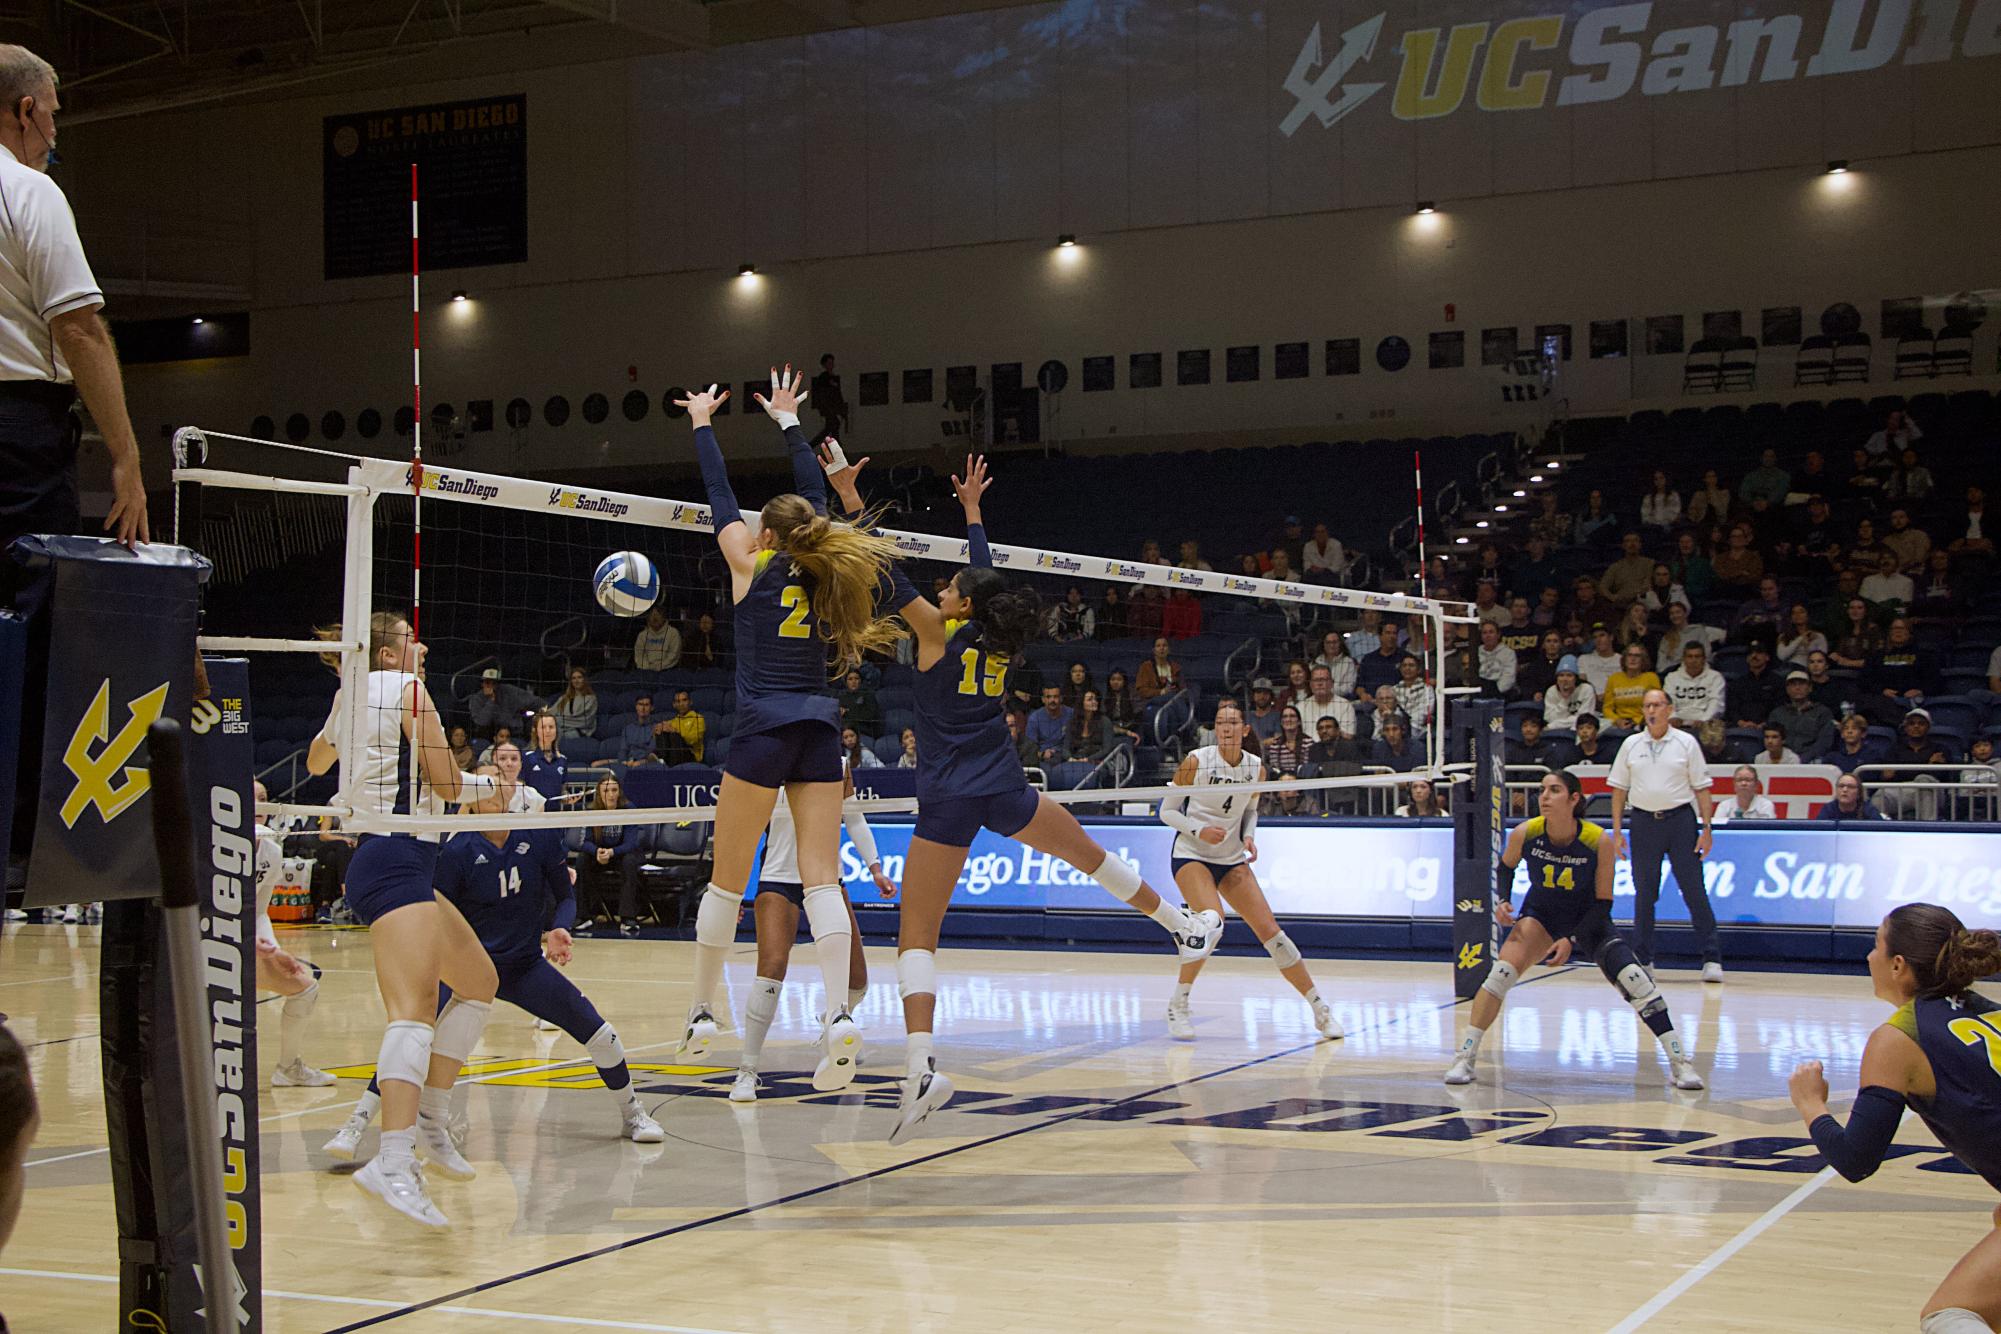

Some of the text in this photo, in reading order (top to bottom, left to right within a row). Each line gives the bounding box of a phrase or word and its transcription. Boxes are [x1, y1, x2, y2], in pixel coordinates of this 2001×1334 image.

[367, 103, 519, 140] UC SAN DIEGO
[778, 585, 811, 639] 2
[957, 647, 1011, 697] 15
[222, 698, 242, 711] THE
[222, 721, 250, 734] WEST
[1222, 795, 1233, 814] 4
[499, 866, 522, 898] 14
[1542, 864, 1575, 890] 14
[1754, 850, 1865, 901] San
